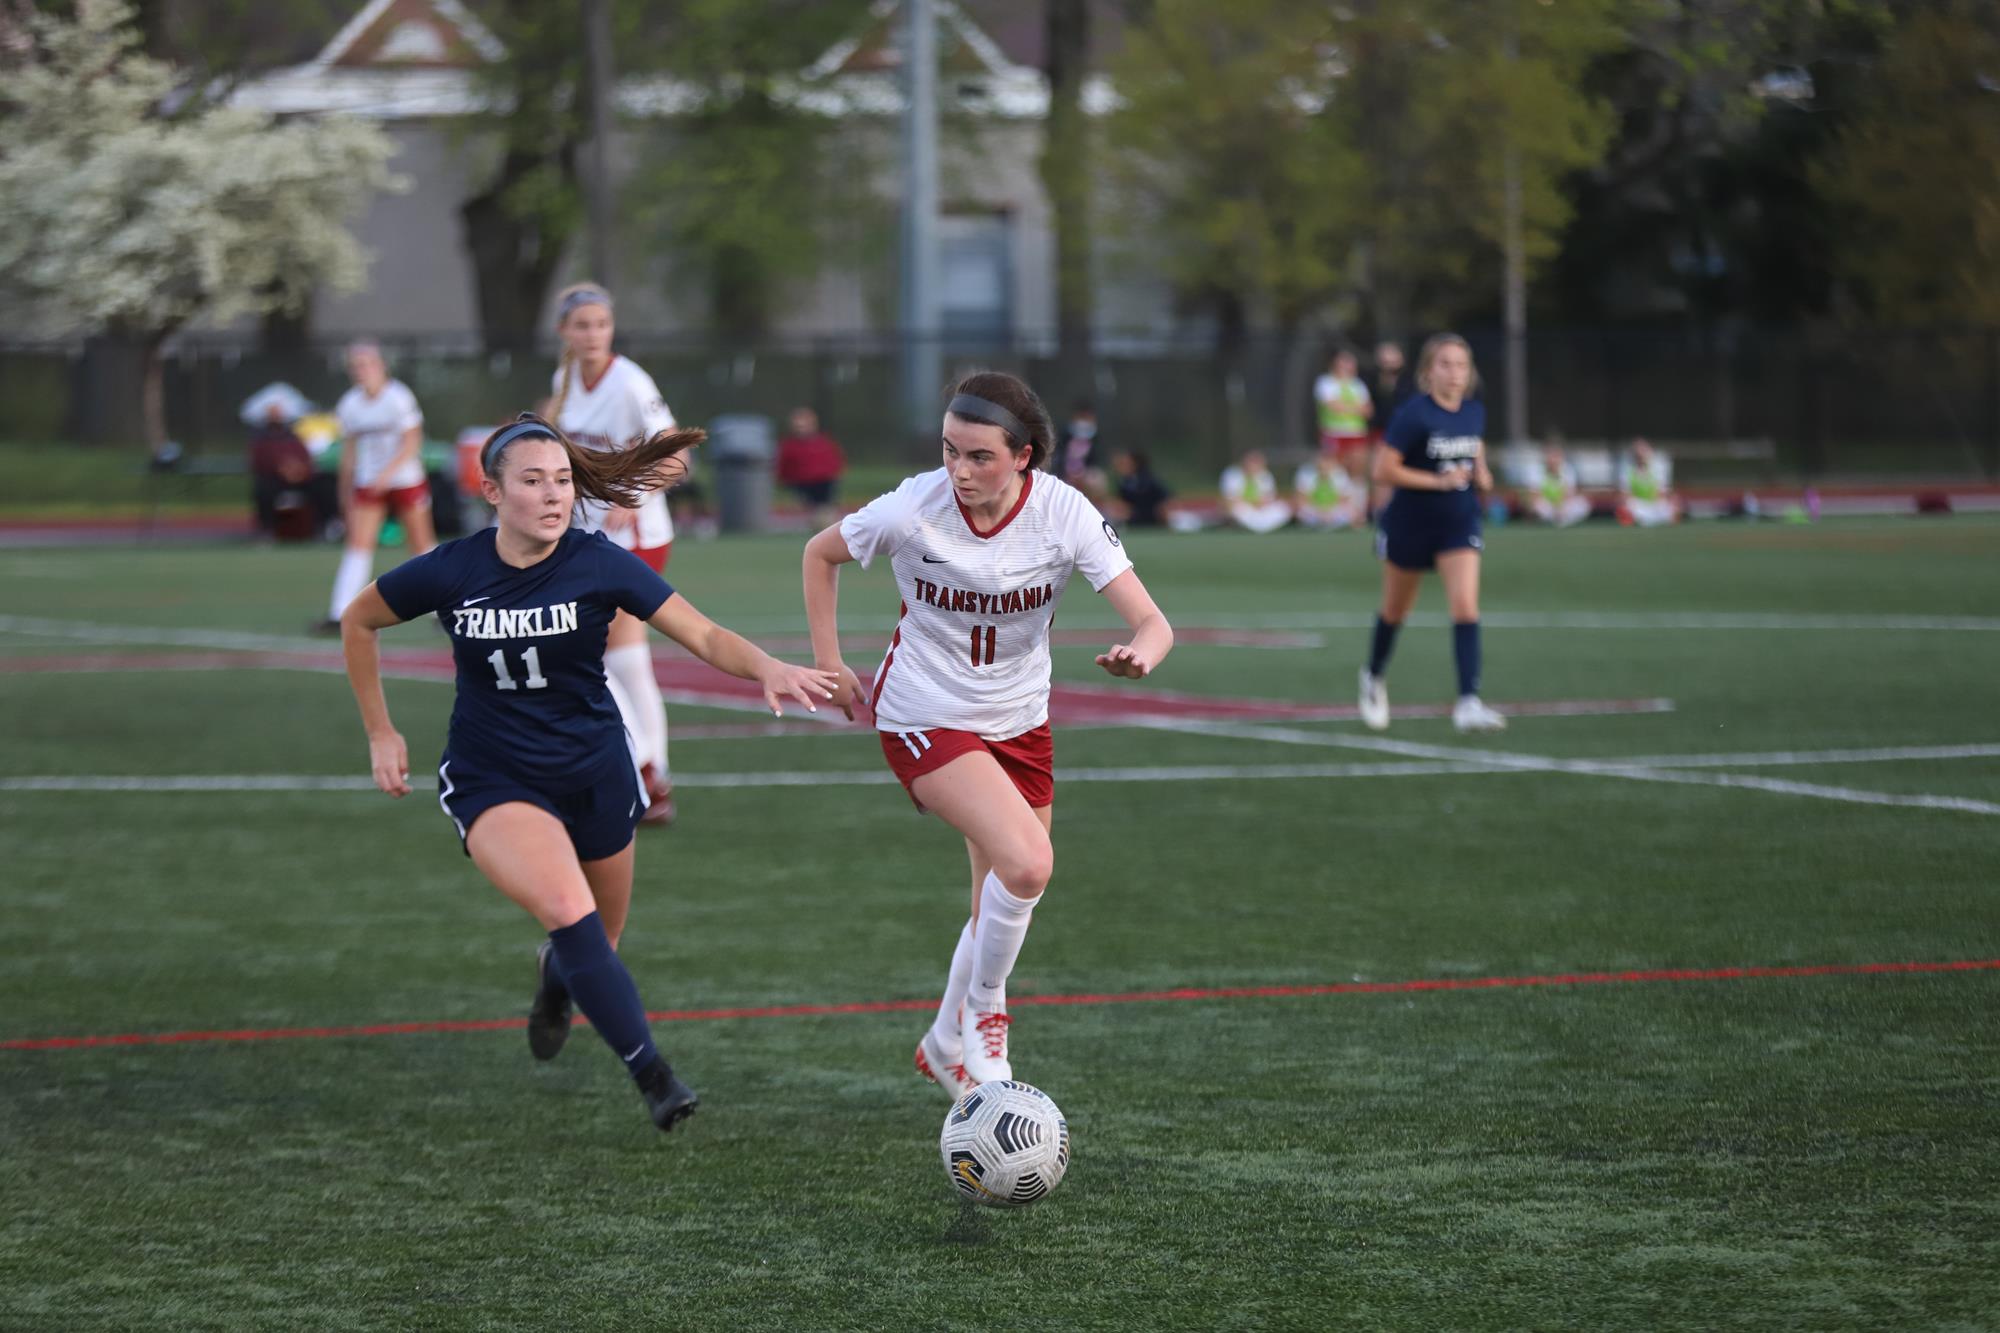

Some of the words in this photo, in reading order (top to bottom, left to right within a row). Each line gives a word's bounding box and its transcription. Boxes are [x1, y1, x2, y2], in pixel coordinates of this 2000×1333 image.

[914, 578, 1053, 615] TRANSYLVANIA
[453, 602, 578, 639] FRANKLIN
[970, 625, 996, 667] 11
[487, 646, 548, 690] 11
[898, 732, 932, 760] 11
